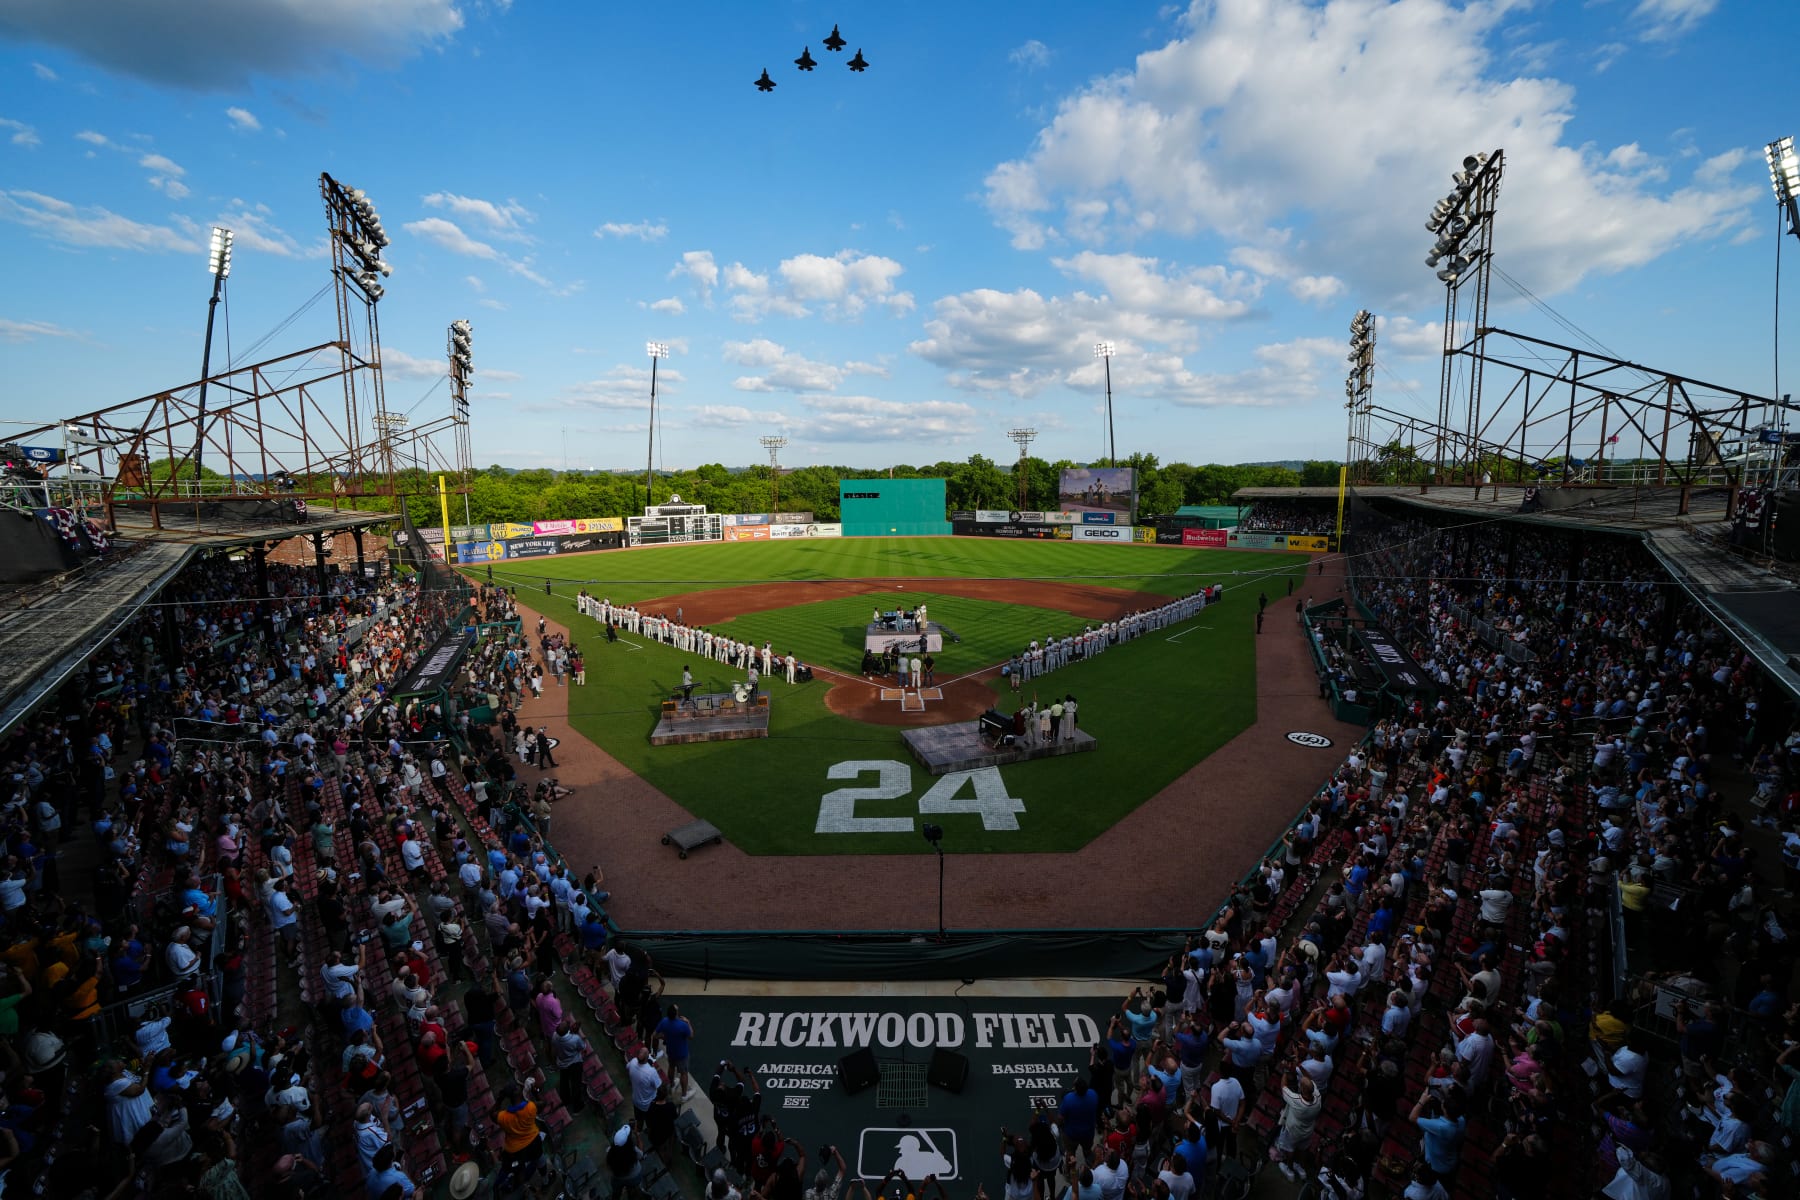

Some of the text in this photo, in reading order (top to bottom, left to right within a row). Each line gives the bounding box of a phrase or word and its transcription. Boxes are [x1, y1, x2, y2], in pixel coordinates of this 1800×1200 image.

[1084, 529, 1119, 538] GEICO
[1186, 534, 1223, 542] Budweiser
[815, 760, 1026, 833] 24
[731, 1012, 1101, 1048] RICKWOOD FIELD
[757, 1063, 839, 1075] AMERICA'
[992, 1063, 1079, 1074] BASEBALL
[766, 1078, 833, 1090] OLDEST
[1014, 1077, 1063, 1089] PARK
[783, 1097, 810, 1107] EST.
